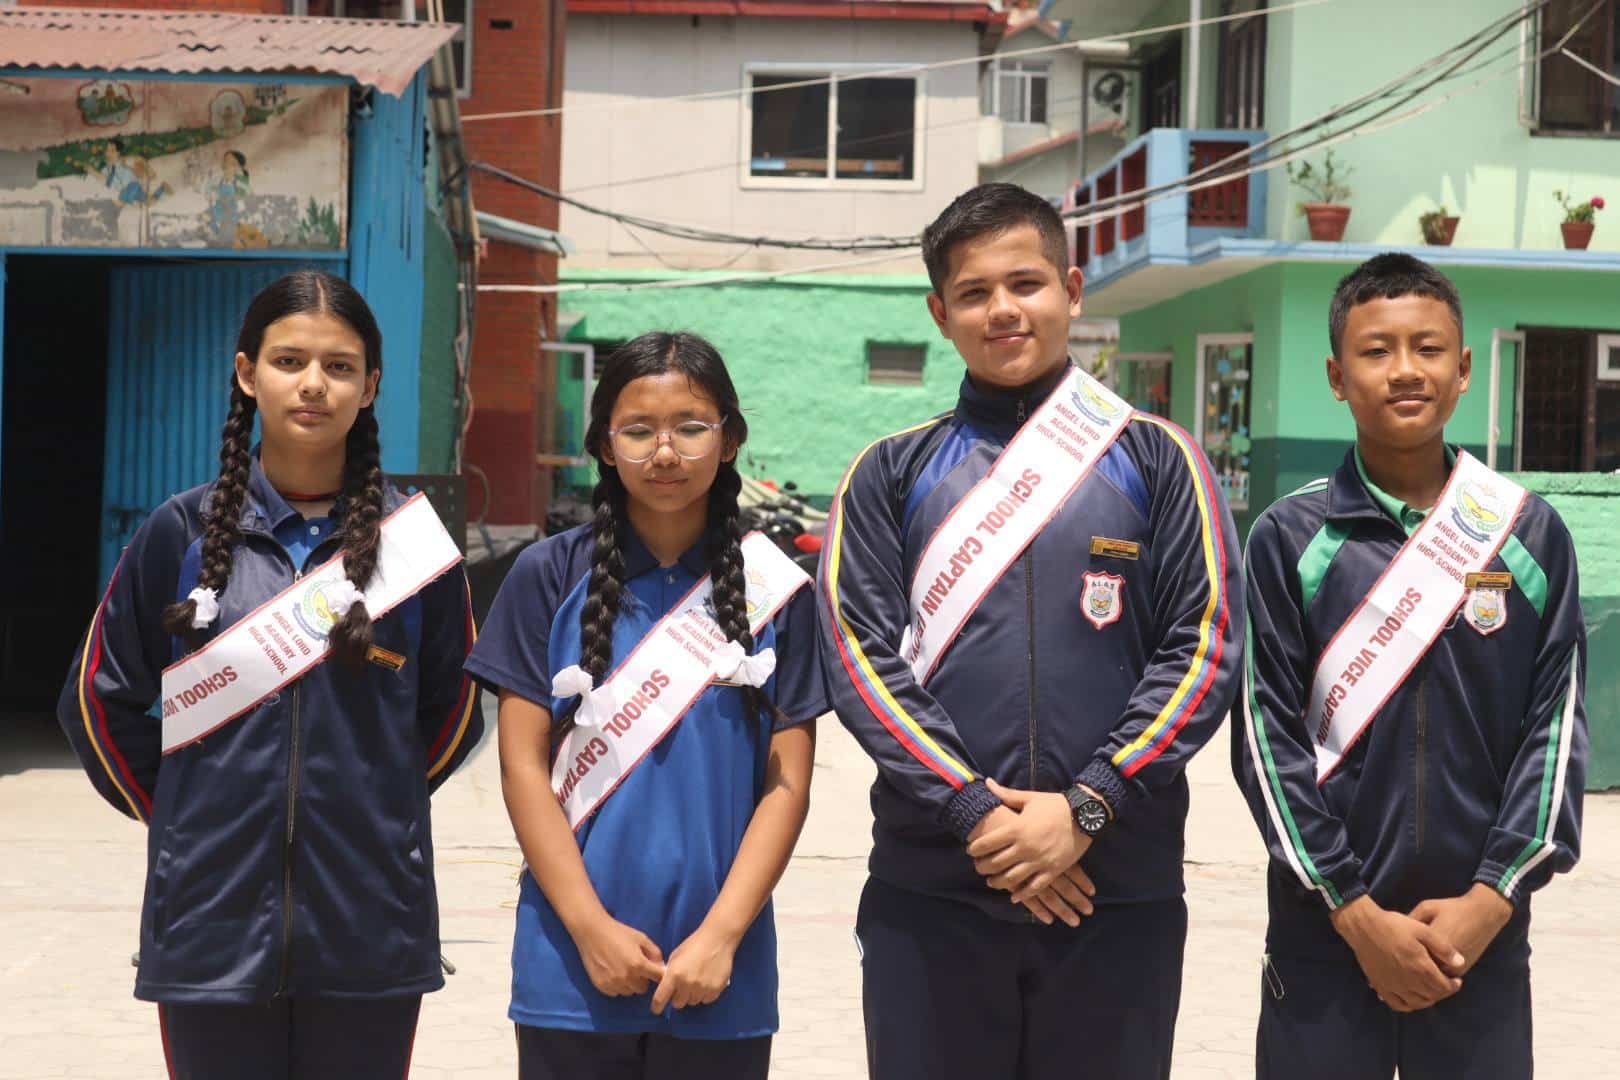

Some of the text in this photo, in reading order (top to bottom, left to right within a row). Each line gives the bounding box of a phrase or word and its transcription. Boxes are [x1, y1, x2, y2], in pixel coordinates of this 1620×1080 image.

[1050, 418, 1088, 447] ACADEMY
[1055, 403, 1100, 441] ANGEL LORD
[1036, 423, 1084, 463] HIGH SCHOOL
[976, 468, 1041, 537] SCHOOL
[1431, 536, 1467, 567] ACADEMY
[1435, 521, 1480, 560] ANGEL LORD
[922, 535, 983, 616] CAPTAIN
[1416, 543, 1437, 560] HIGH
[1435, 557, 1465, 584] SCHOOL
[264, 624, 296, 659] ACADEMY
[272, 611, 311, 656] ANGEL LORD
[681, 622, 715, 653] ACADEMY
[263, 643, 288, 677] SCHOOL
[683, 642, 712, 668] SCHOOL
[1316, 586, 1422, 747] SCHOOL VICE CAPTAIN
[176, 665, 238, 709] SCHOOL
[555, 668, 671, 806] SCHOOL CAPTAIN
